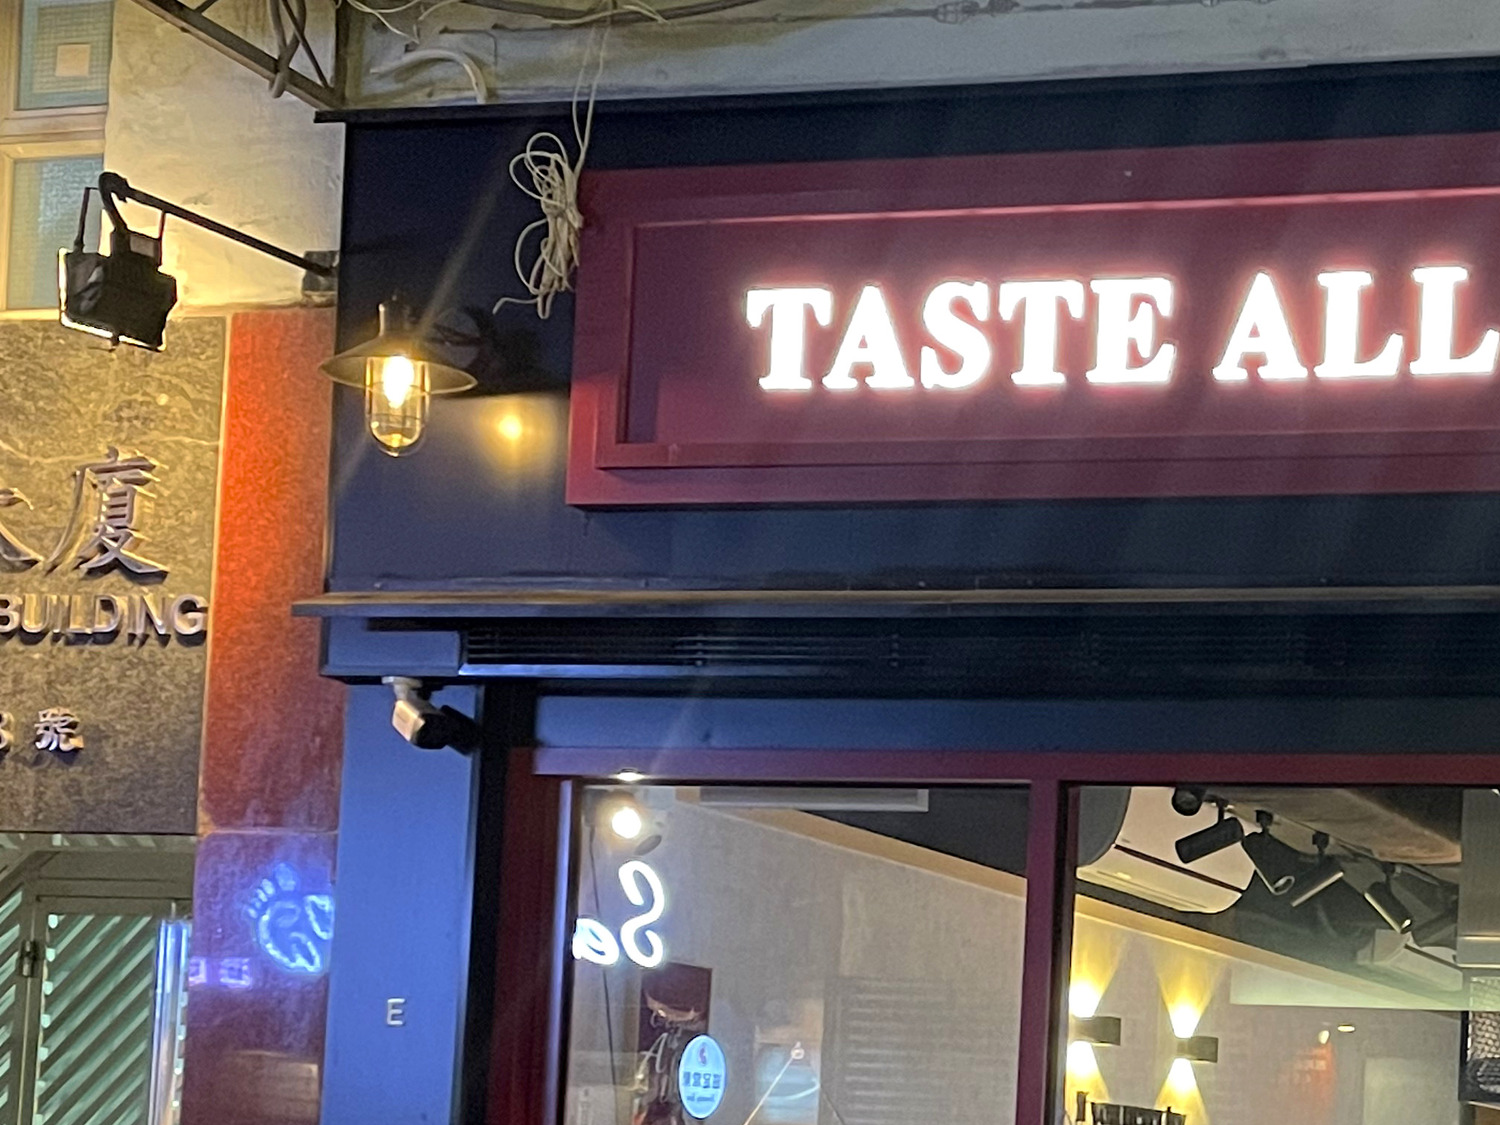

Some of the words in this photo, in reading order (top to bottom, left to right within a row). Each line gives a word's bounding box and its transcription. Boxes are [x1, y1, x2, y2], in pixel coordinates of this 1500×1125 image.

[745, 275, 1177, 391] TASTE
[1211, 264, 1500, 382] ALL
[0, 593, 208, 636] BUILDING
